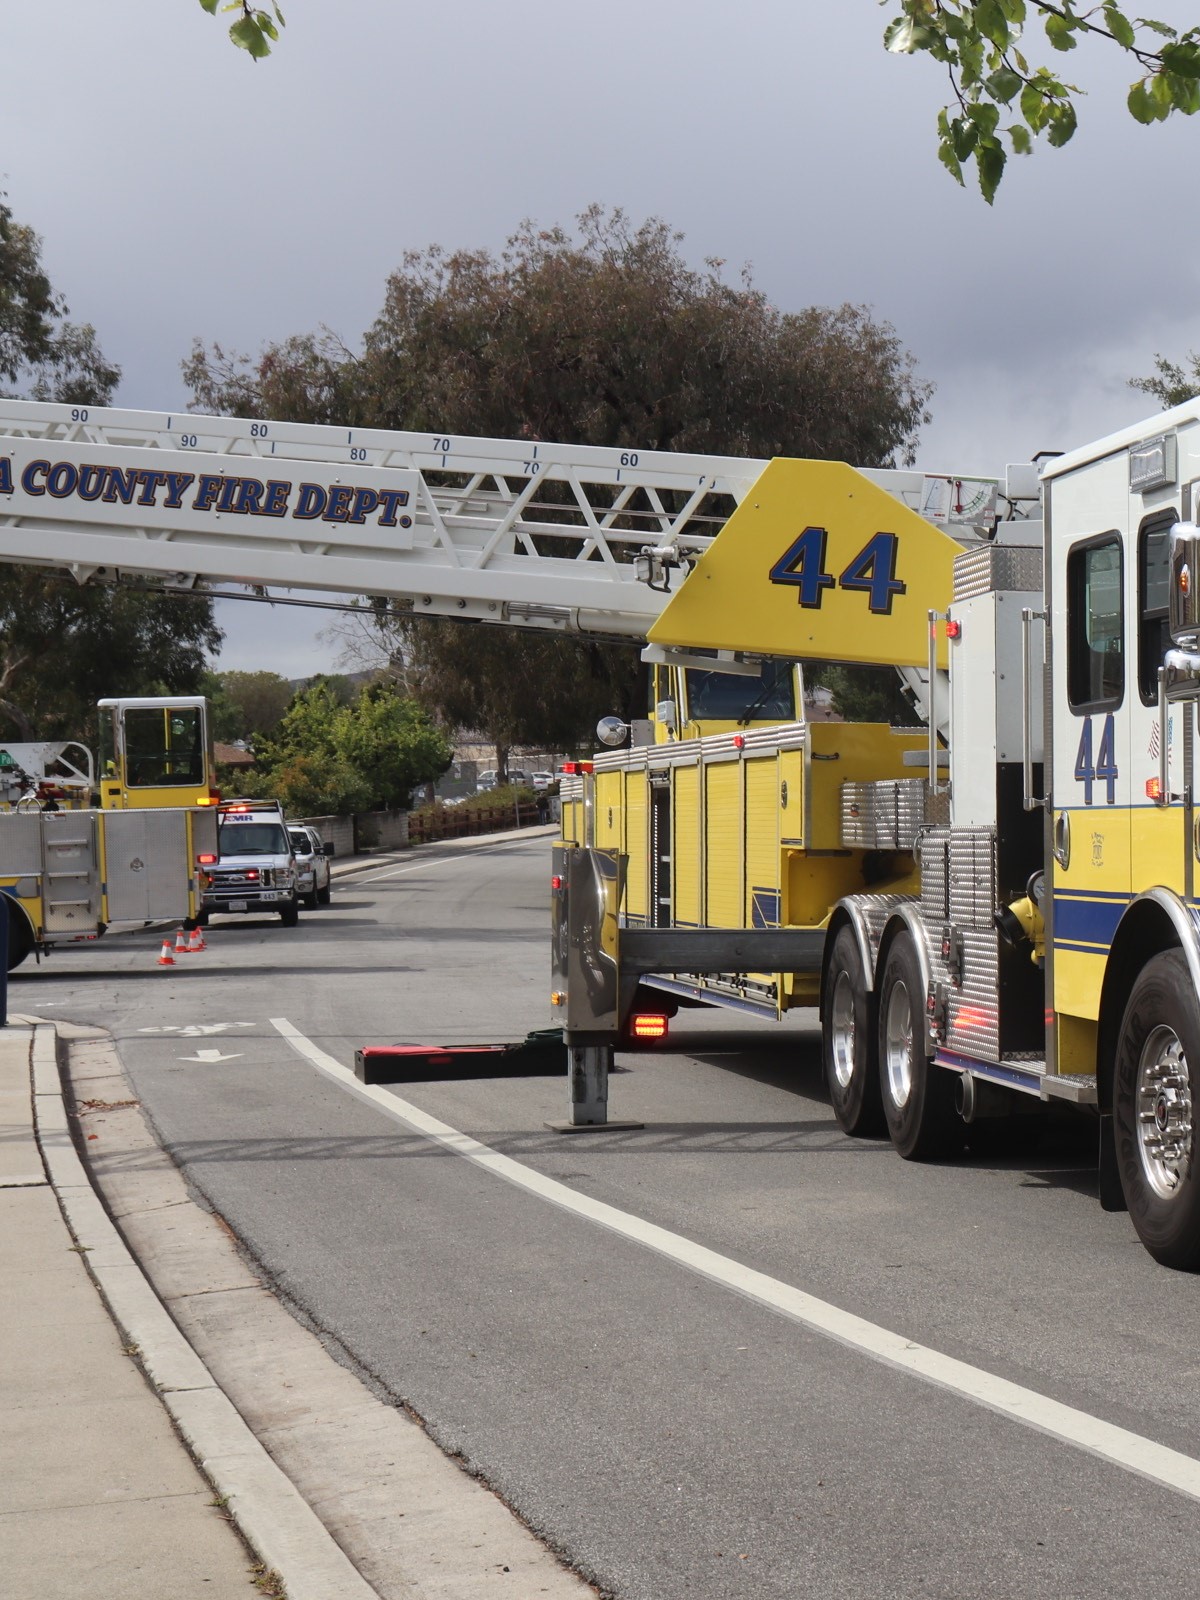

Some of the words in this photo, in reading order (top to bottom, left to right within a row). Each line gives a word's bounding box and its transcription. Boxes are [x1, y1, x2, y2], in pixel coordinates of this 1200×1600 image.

[71, 408, 89, 422] 90
[250, 423, 268, 438] 80
[181, 434, 197, 447] 90
[432, 438, 450, 452] 70
[350, 448, 367, 461] 80
[620, 452, 639, 467] 60
[21, 459, 195, 507] COUNTY
[192, 474, 292, 517] FIRE
[292, 482, 412, 529] DEPT.
[769, 526, 907, 616] 44
[1074, 711, 1118, 805] 44
